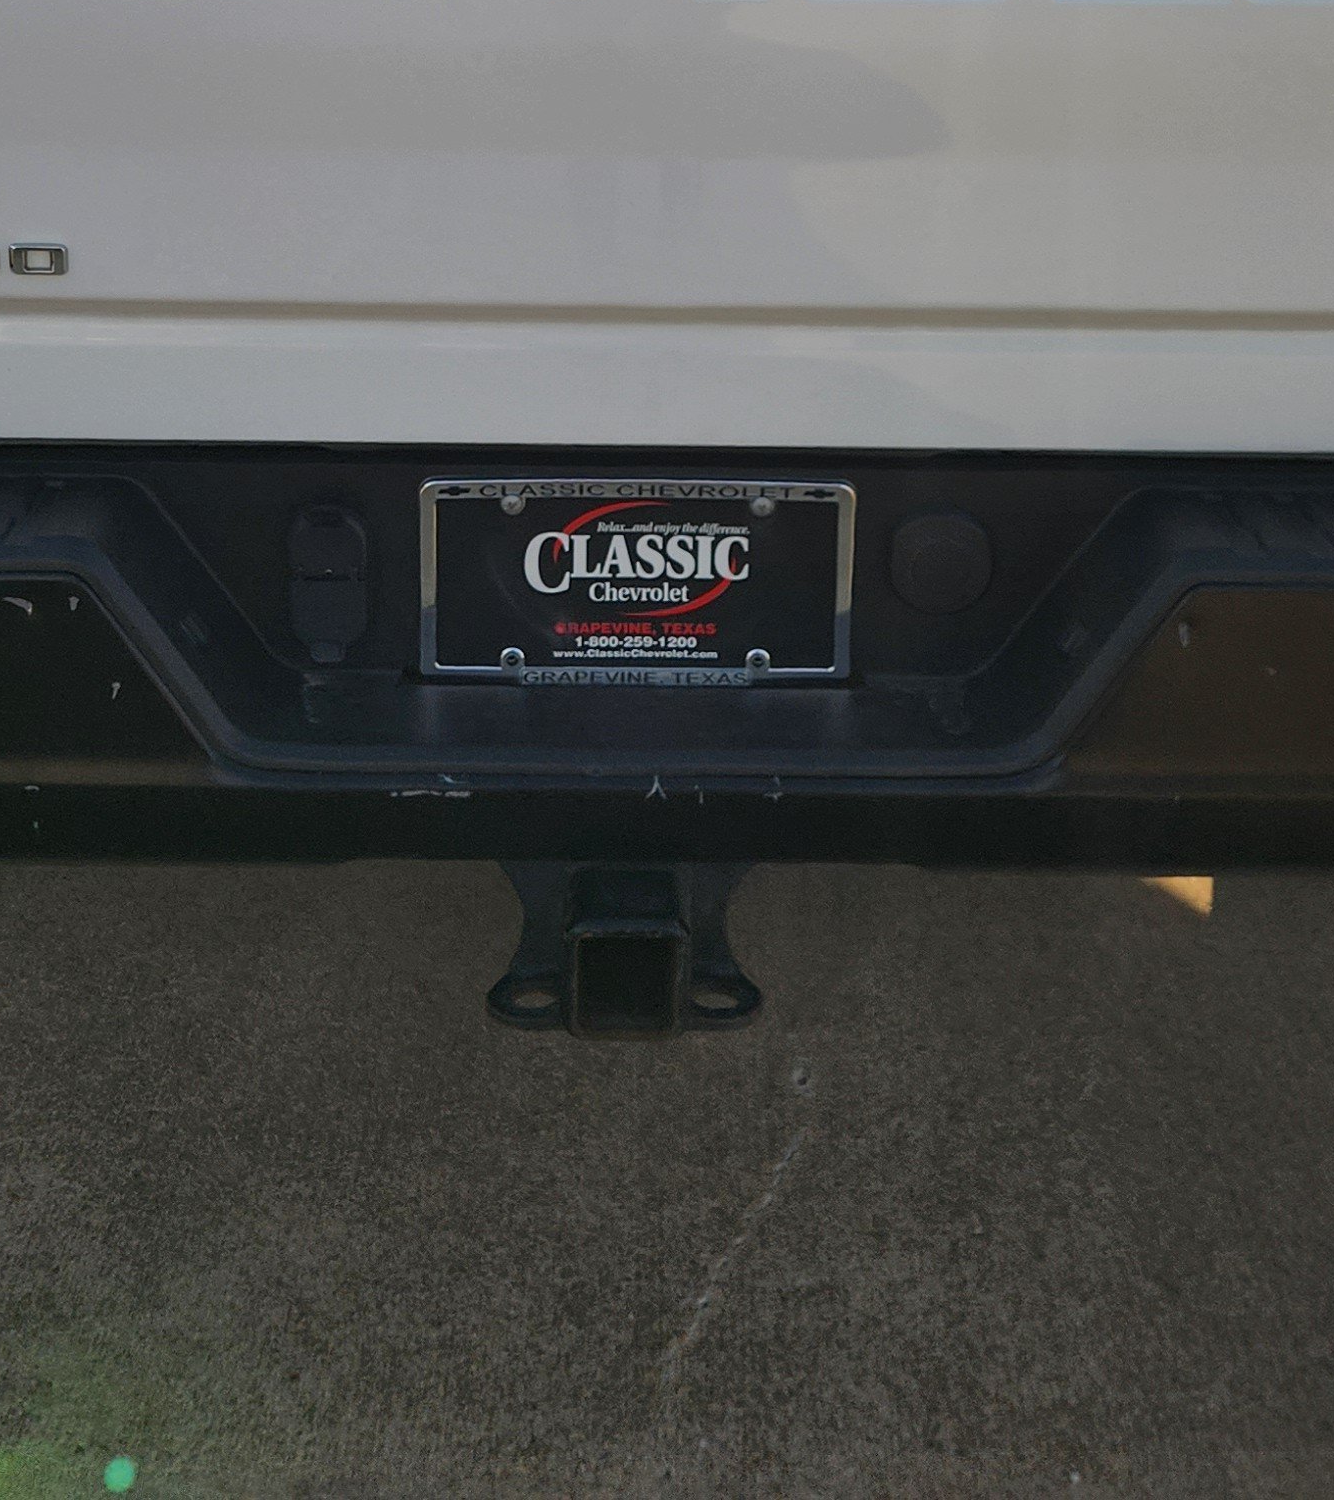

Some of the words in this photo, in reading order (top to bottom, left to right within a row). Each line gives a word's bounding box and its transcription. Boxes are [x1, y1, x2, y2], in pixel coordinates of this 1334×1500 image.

[479, 483, 605, 497] CLASSIC
[616, 484, 794, 499] CHEVROLET
[682, 522, 698, 534] the
[524, 531, 749, 593] CLASSIC
[589, 581, 690, 603] Chevrolet
[661, 623, 717, 636] TEXAS
[575, 636, 698, 649] 1-800-259-1200
[553, 649, 718, 659] www.ClassicChevrolet.com
[672, 671, 748, 685] TEXAS
